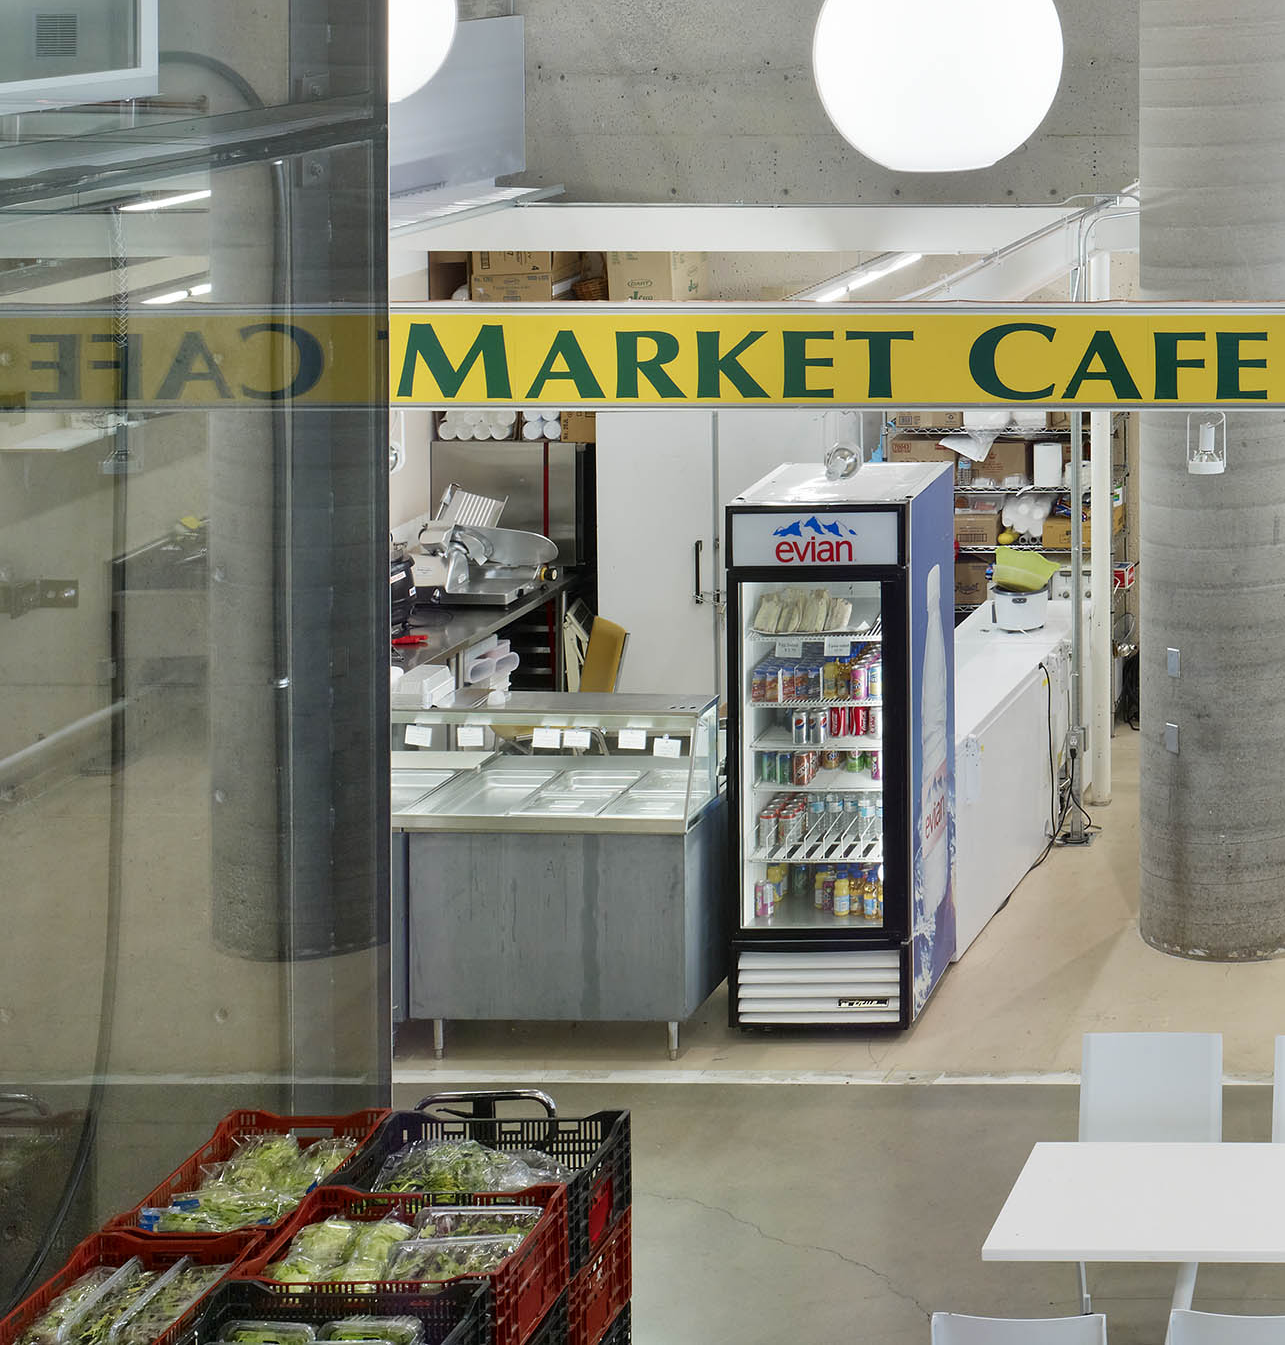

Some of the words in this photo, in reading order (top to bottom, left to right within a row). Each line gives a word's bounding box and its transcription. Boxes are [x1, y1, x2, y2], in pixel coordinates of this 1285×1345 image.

[396, 323, 914, 399] MARKET
[968, 322, 1268, 401] CAFE
[774, 536, 854, 563] evian
[924, 793, 946, 841] evian
